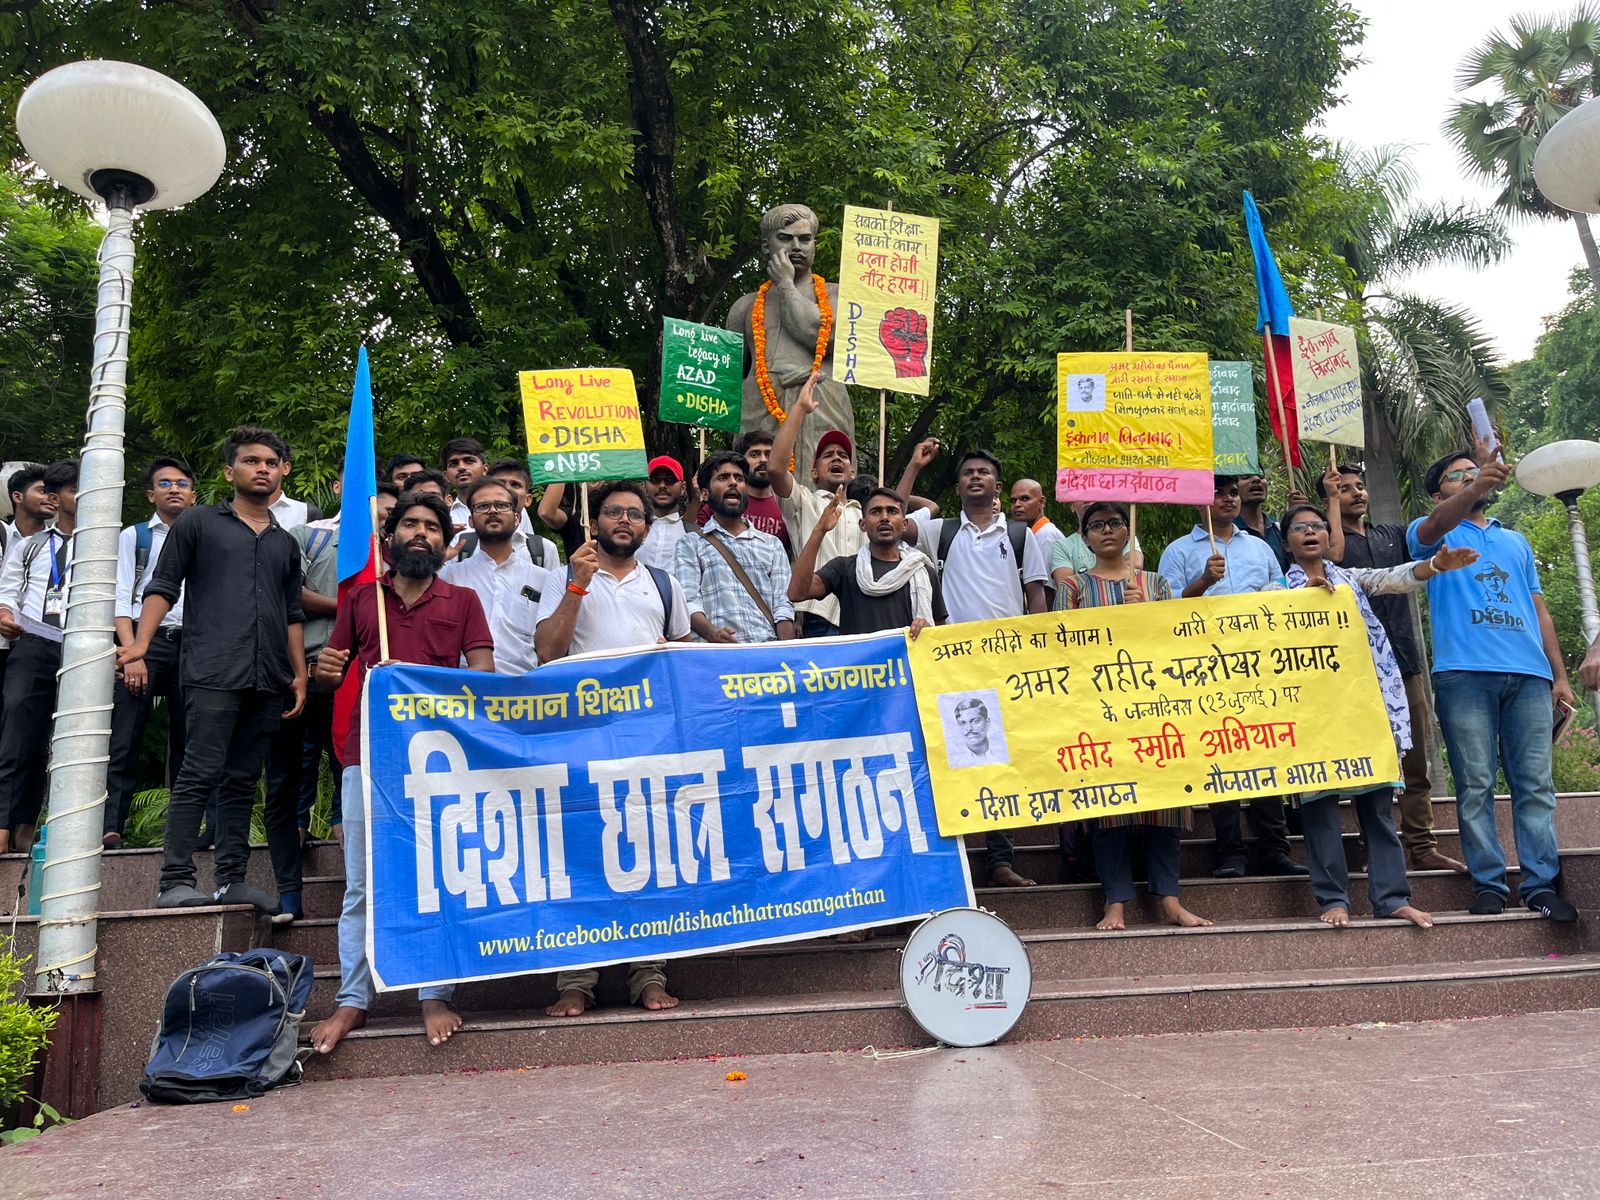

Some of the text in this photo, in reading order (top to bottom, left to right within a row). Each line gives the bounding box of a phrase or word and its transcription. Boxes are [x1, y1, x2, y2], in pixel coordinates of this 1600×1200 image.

[855, 213, 887, 231] सबको
[855, 232, 891, 248] सबको
[857, 252, 919, 274] वरना होगी
[860, 269, 886, 290] नींद
[673, 324, 696, 344] Long
[844, 302, 862, 384] DISHA
[721, 355, 731, 368] of
[532, 374, 611, 395] Long Live
[677, 365, 716, 385] AZAD
[539, 400, 639, 421] REVOLUTION
[686, 393, 729, 415] DISHA
[553, 425, 627, 448] DISHA
[557, 452, 601, 472] NBS
[1081, 451, 1118, 465] नौजवान
[1120, 455, 1143, 466] भारत
[1066, 470, 1096, 490] दिशा
[1130, 471, 1179, 493] संगठन
[1470, 605, 1525, 627] Disha
[932, 640, 973, 661] अमर
[981, 629, 1023, 654] शहीदों
[1029, 632, 1047, 649] का
[1173, 611, 1207, 637] जारी
[1216, 613, 1260, 634] रखना
[1259, 604, 1278, 631] है
[719, 658, 908, 699] सबको रोजगार!!
[1005, 643, 1341, 701] अमर शहीद चन्द्रशेखर आज़ाद
[388, 678, 654, 721] सबको समान शिक्षा!
[1099, 699, 1118, 722] के
[1125, 694, 1192, 720] जन्मदिवस
[1281, 686, 1302, 703] पर
[1057, 716, 1296, 772] शहीद स्मृति अभियान
[976, 786, 1021, 820] दिशा
[1068, 778, 1138, 809] संगठन
[1202, 764, 1277, 794] नौजवान
[1286, 761, 1328, 785] भारत
[1332, 756, 1374, 780] सभा
[403, 702, 929, 914] दिशा छात्र संगठन
[477, 887, 886, 957] www.facebook.com/dishachhatrasangathan
